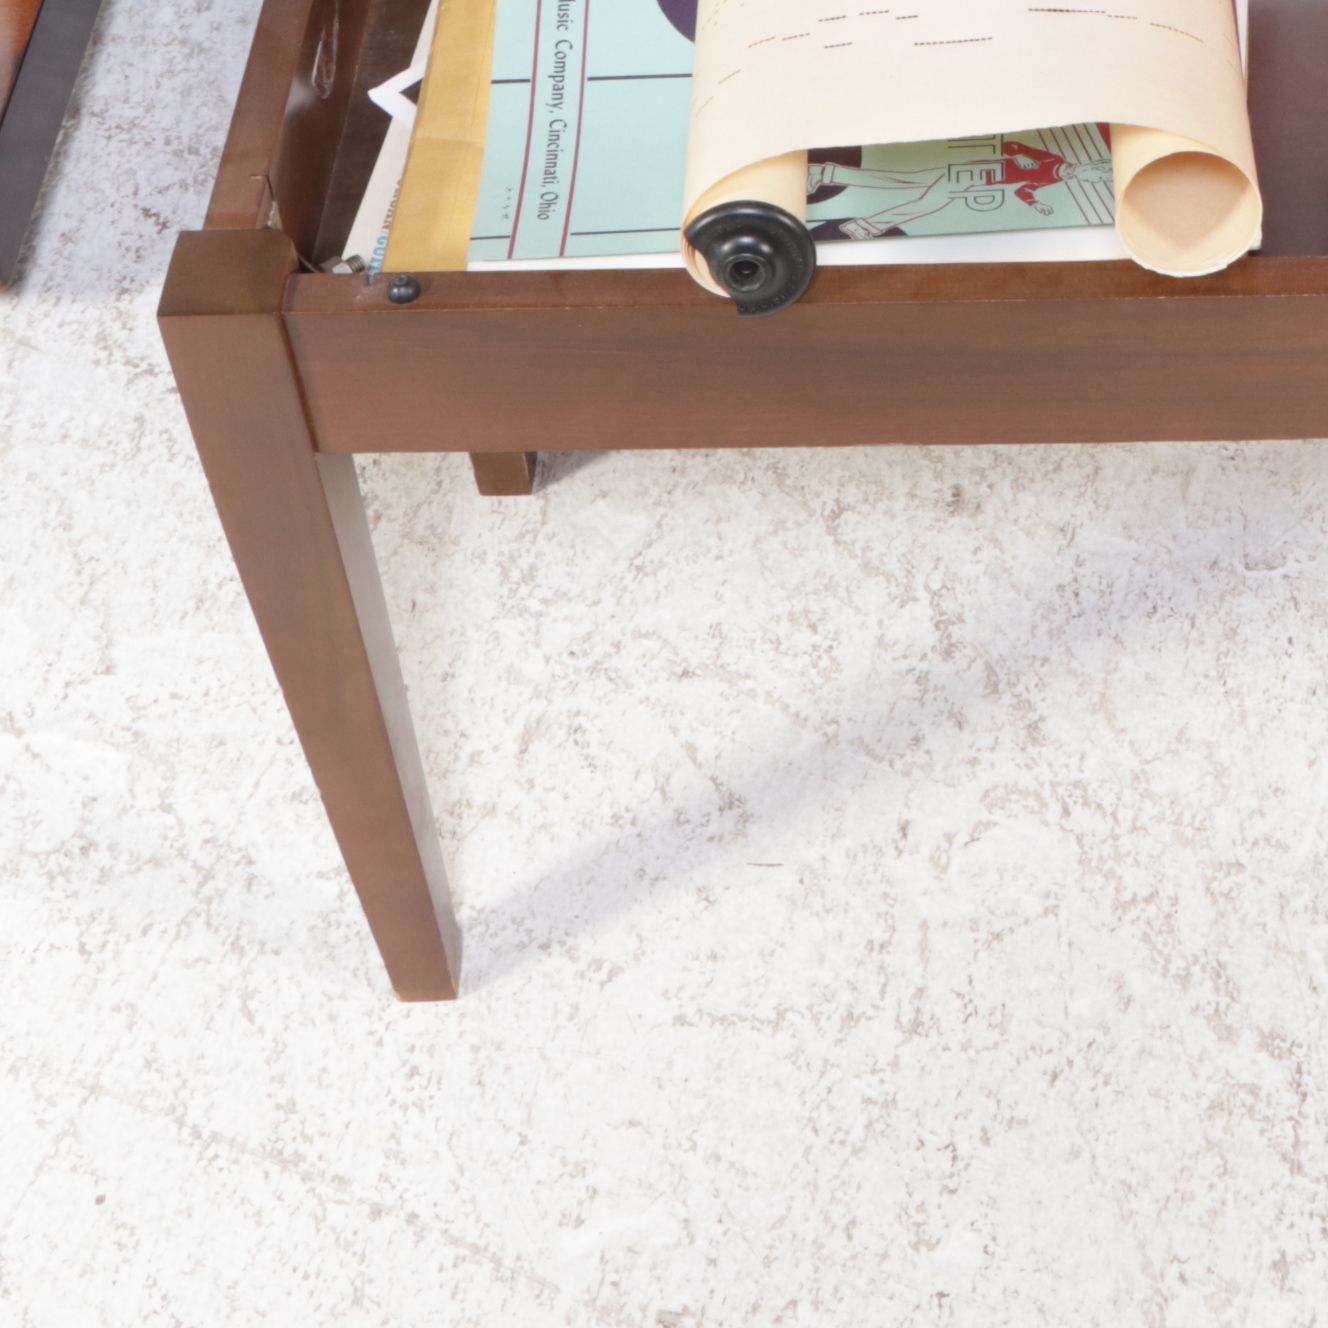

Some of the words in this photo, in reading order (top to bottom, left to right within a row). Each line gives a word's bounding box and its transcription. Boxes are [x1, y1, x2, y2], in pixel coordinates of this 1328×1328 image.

[545, 39, 573, 114] Company,
[541, 119, 568, 188] Cincinnati,
[537, 191, 559, 221] Ohio
